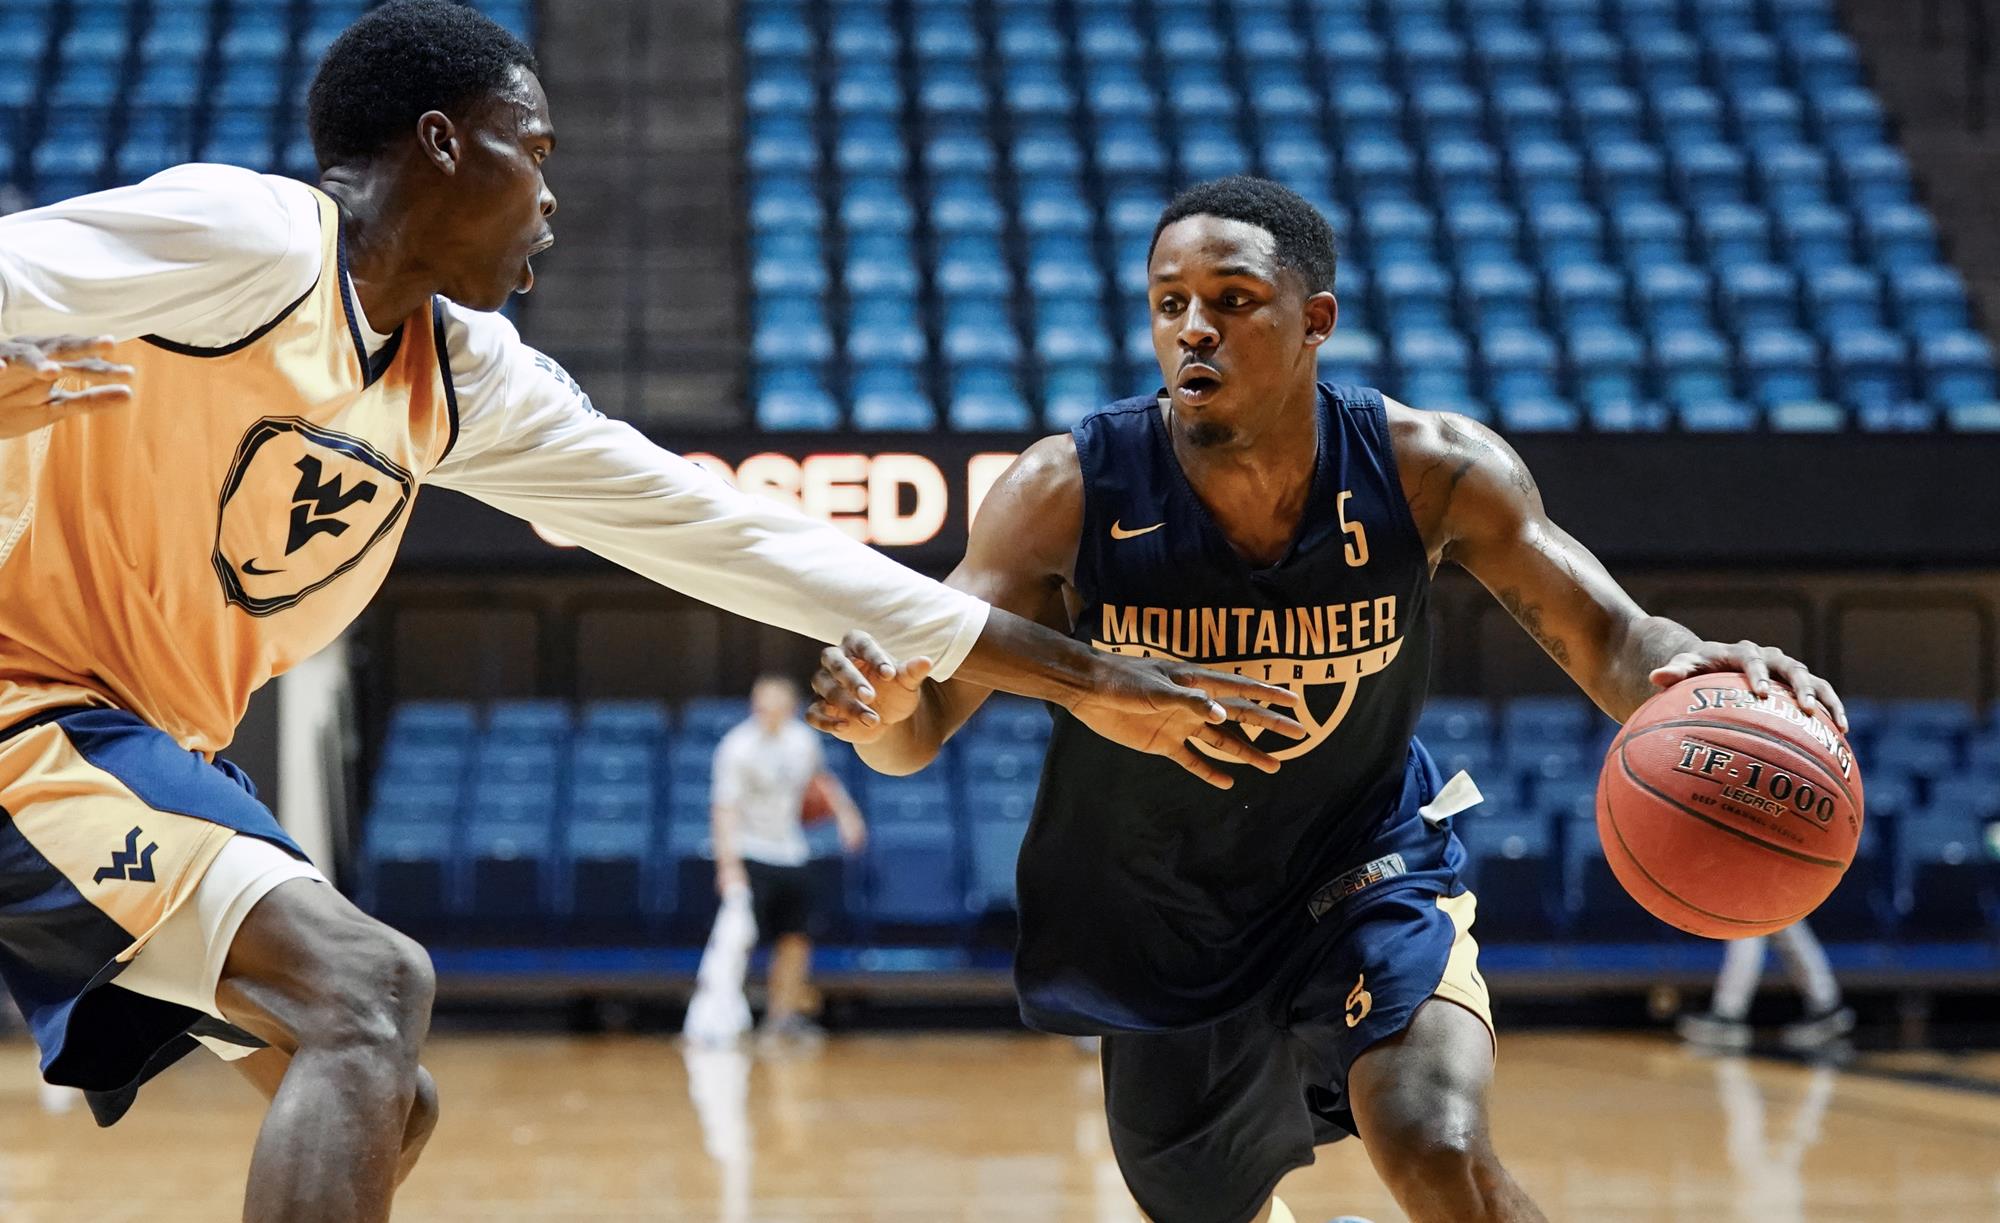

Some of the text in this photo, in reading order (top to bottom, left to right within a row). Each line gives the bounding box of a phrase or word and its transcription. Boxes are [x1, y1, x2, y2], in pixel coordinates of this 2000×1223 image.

[1337, 490, 1370, 568] 5
[1102, 595, 1397, 658] MOUNTAINEER
[1686, 687, 1852, 780] SPALDING
[1679, 739, 1835, 823] TF-1000
[1720, 784, 1789, 818] LEGACY
[1345, 972, 1373, 1028] 5
